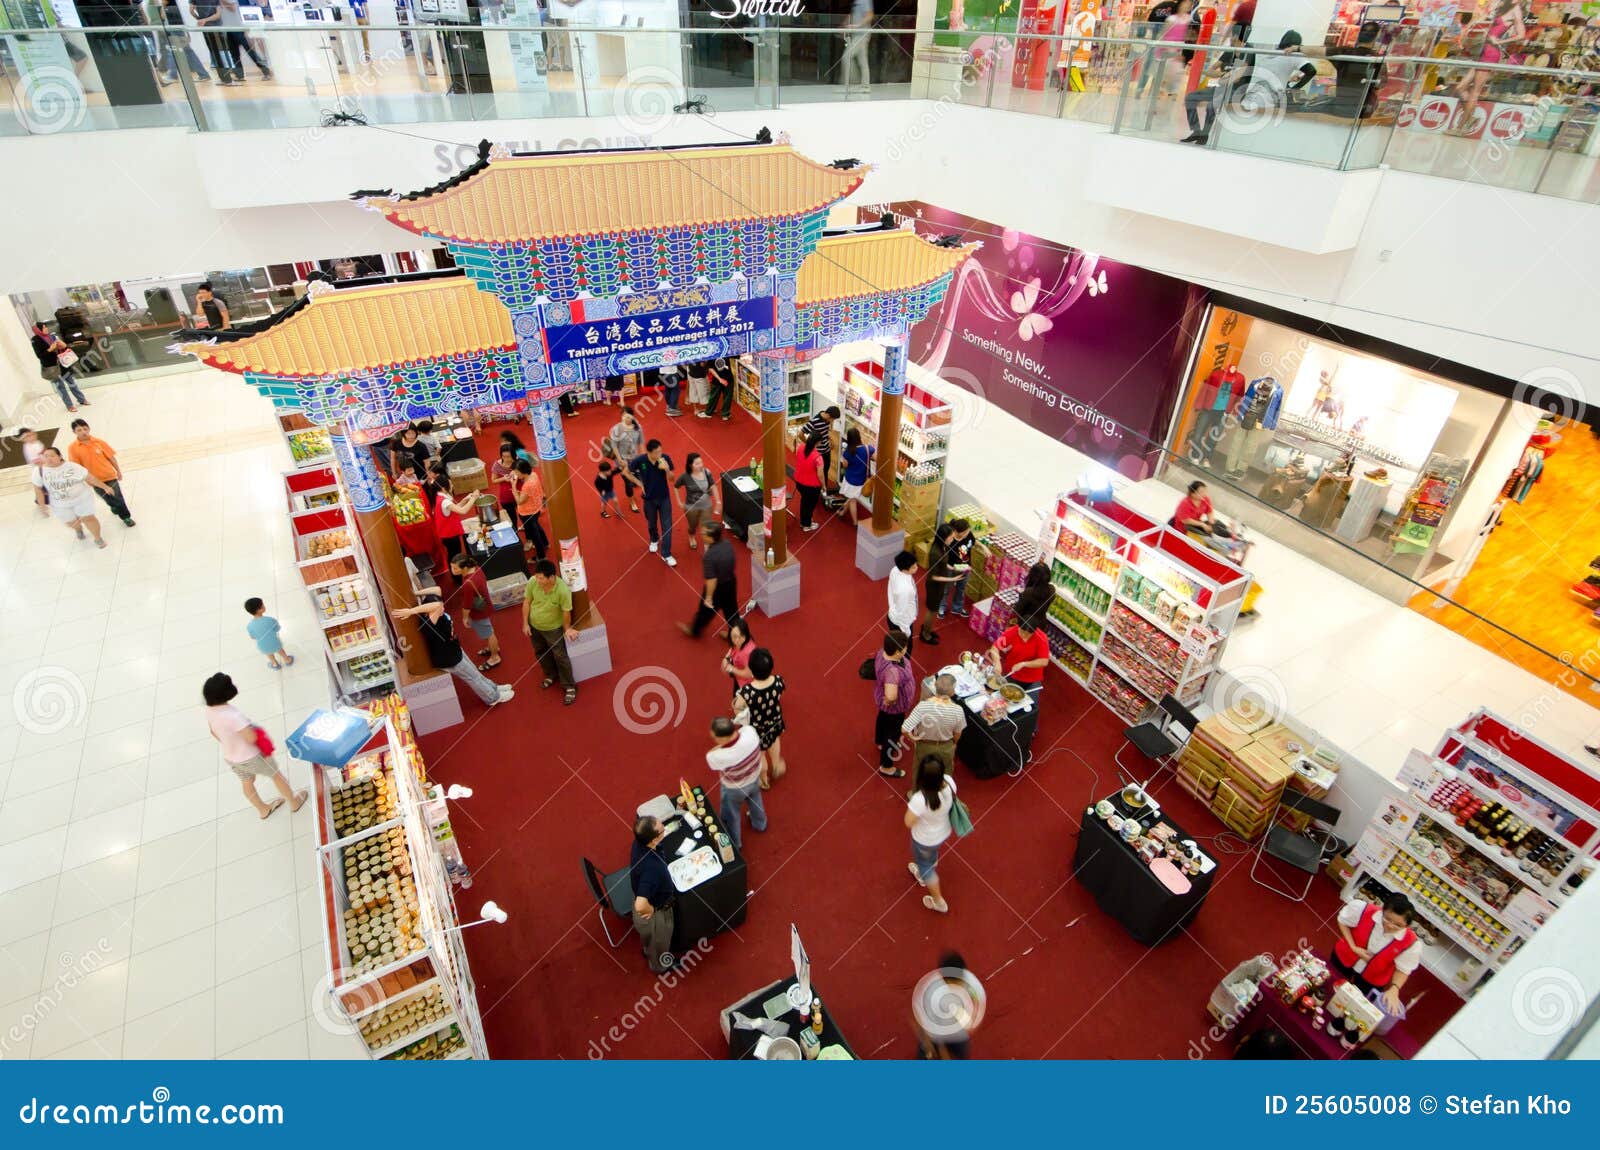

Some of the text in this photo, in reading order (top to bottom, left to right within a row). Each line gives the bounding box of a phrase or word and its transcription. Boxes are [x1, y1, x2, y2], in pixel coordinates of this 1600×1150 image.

[567, 321, 754, 359] Taiwan Foods & Beverages Fair 2012
[585, 304, 742, 345] 台湾食品及饮料展
[962, 328, 1013, 363] Something
[1003, 368, 1056, 407] Something
